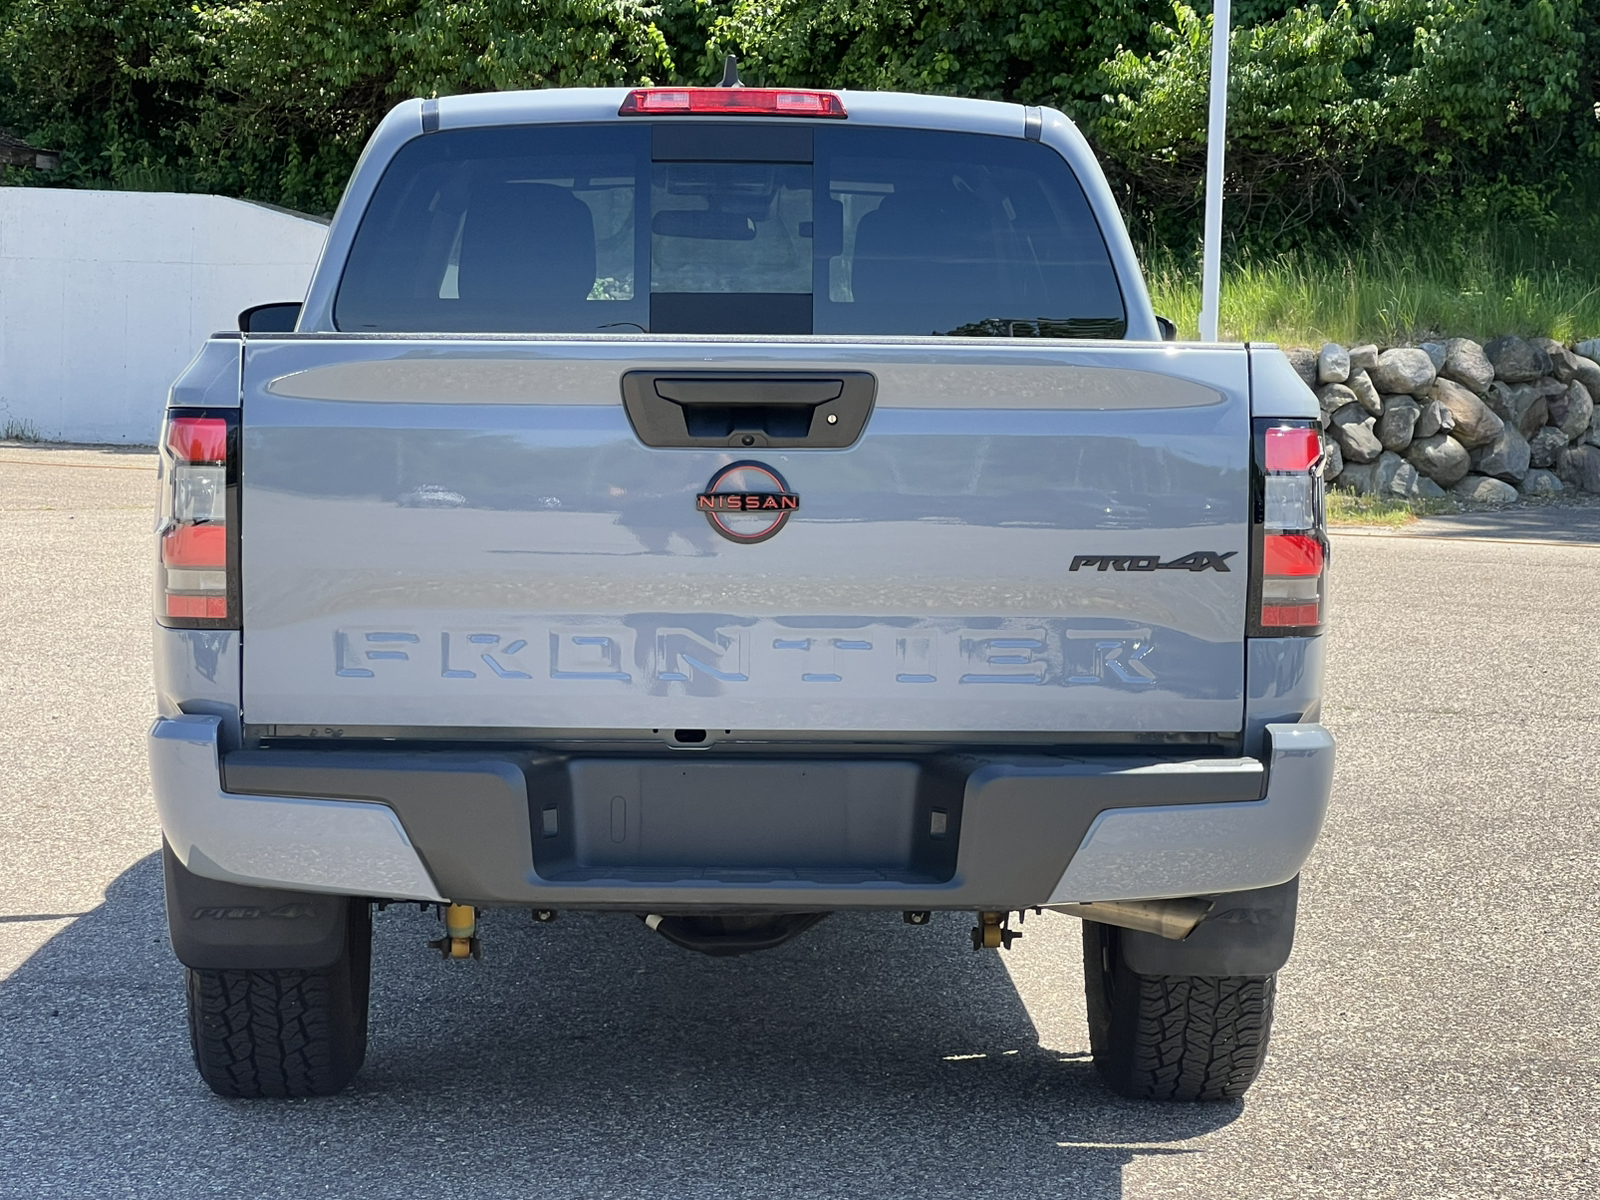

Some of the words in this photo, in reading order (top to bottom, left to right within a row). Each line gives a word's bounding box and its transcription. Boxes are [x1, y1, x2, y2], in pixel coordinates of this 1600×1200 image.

[699, 495, 798, 509] NISSAN
[1068, 551, 1239, 572] PRO-4X
[334, 626, 1157, 685] FRONTIER
